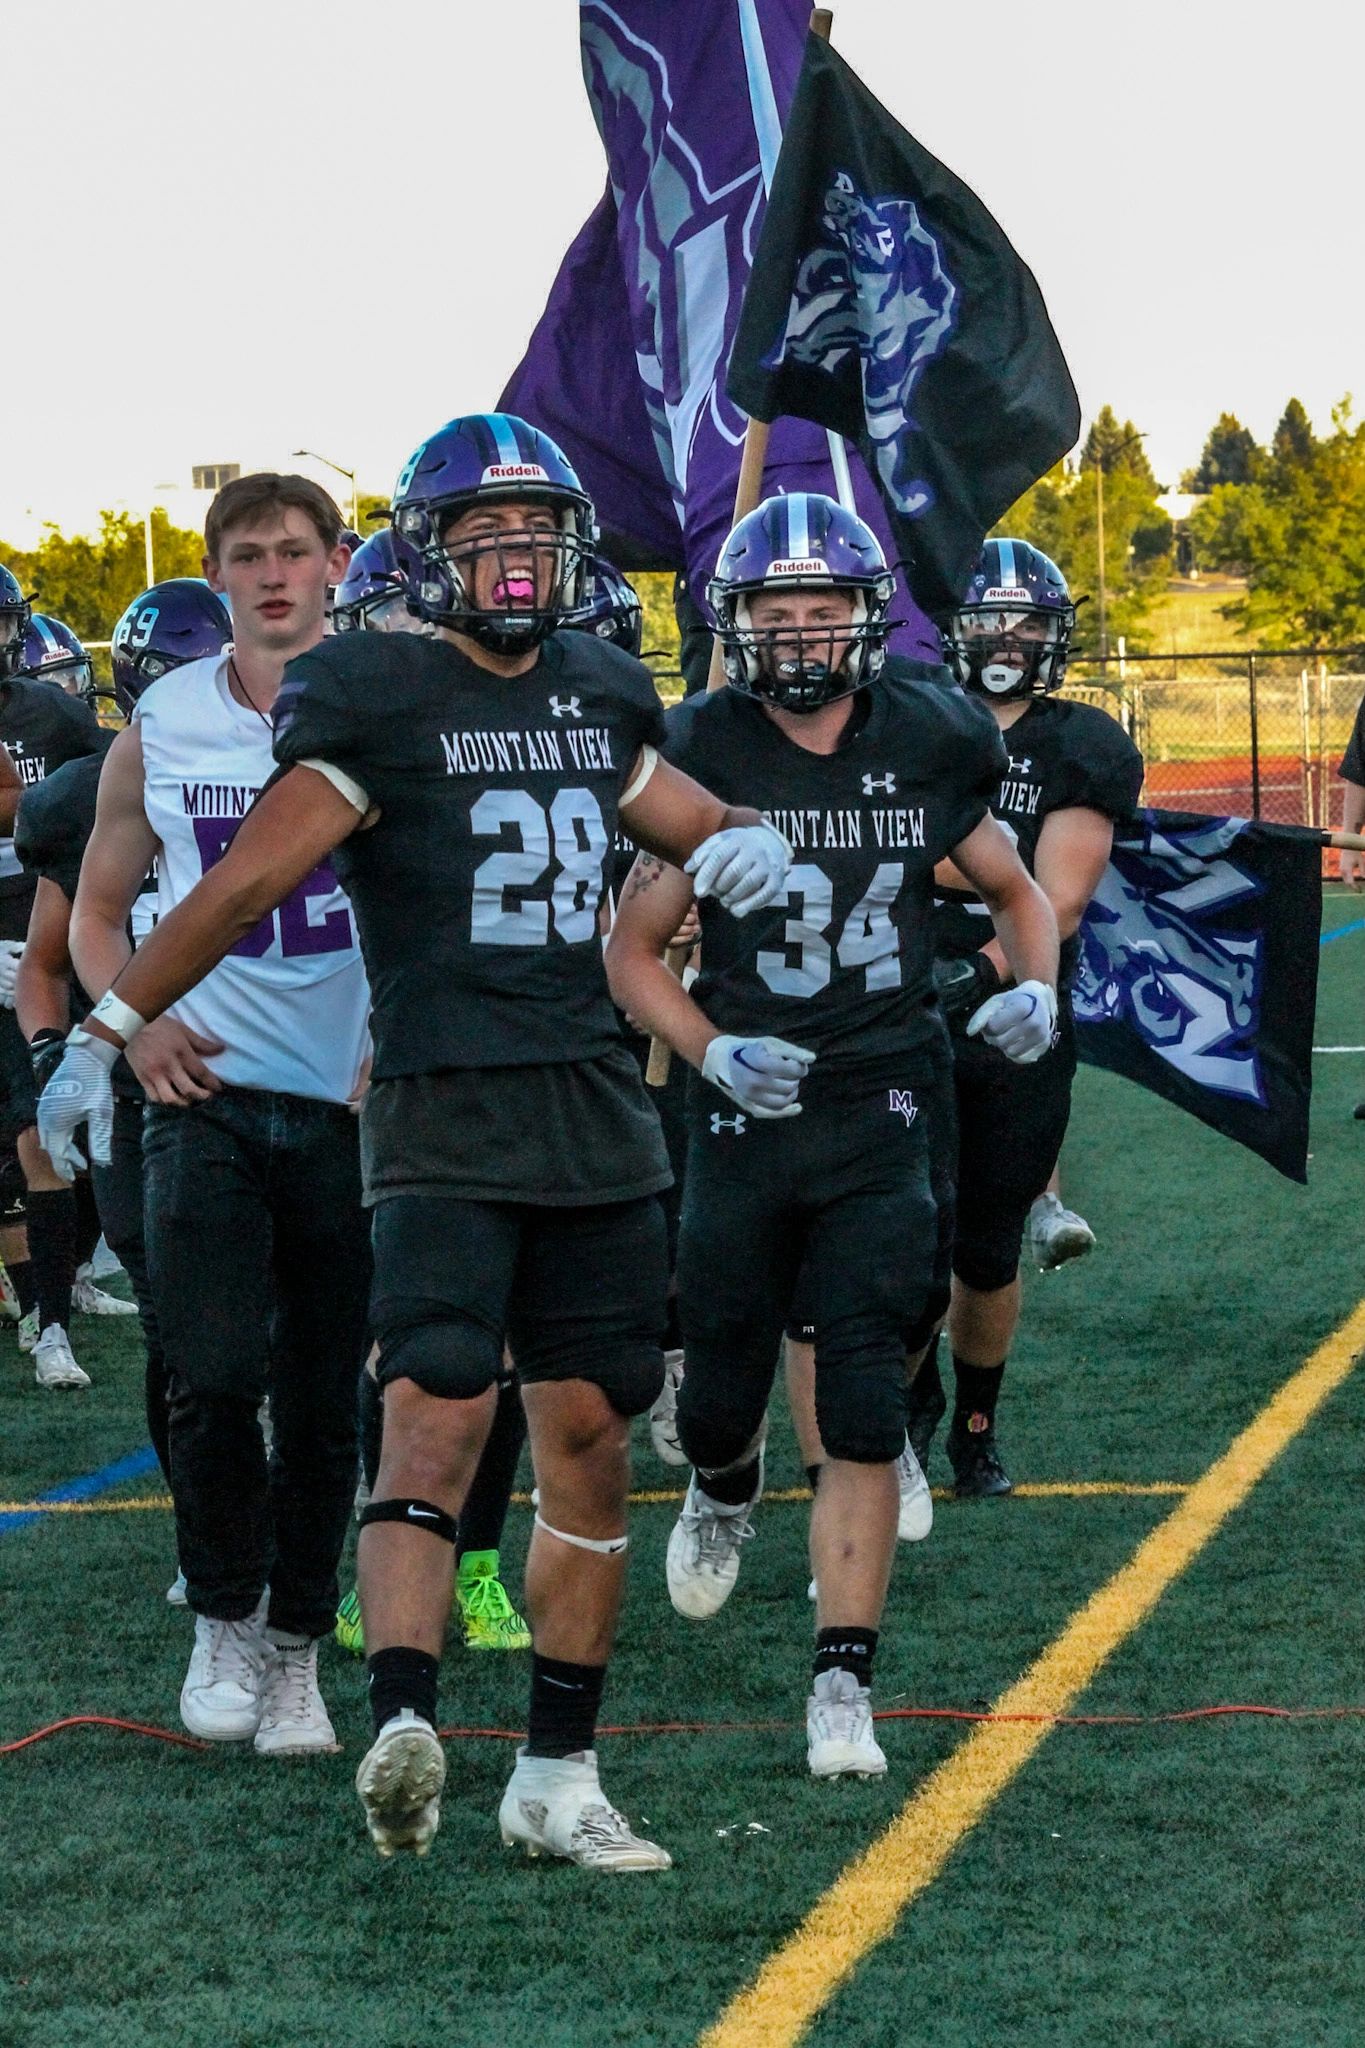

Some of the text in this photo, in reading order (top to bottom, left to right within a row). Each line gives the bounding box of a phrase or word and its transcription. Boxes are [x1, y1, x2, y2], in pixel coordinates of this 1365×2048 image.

[490, 466, 541, 477] Riddell
[773, 562, 822, 573] Riddell
[989, 589, 1027, 598] Riddell
[116, 607, 160, 648] 69
[440, 728, 616, 775] MOUNTAIN VIEW
[182, 783, 263, 816] MOUNT
[1000, 781, 1042, 815] VIEW
[763, 808, 926, 848] UNTAIN VIEW
[470, 788, 608, 946] 28
[756, 862, 904, 998] 34
[889, 1089, 918, 1128] MV
